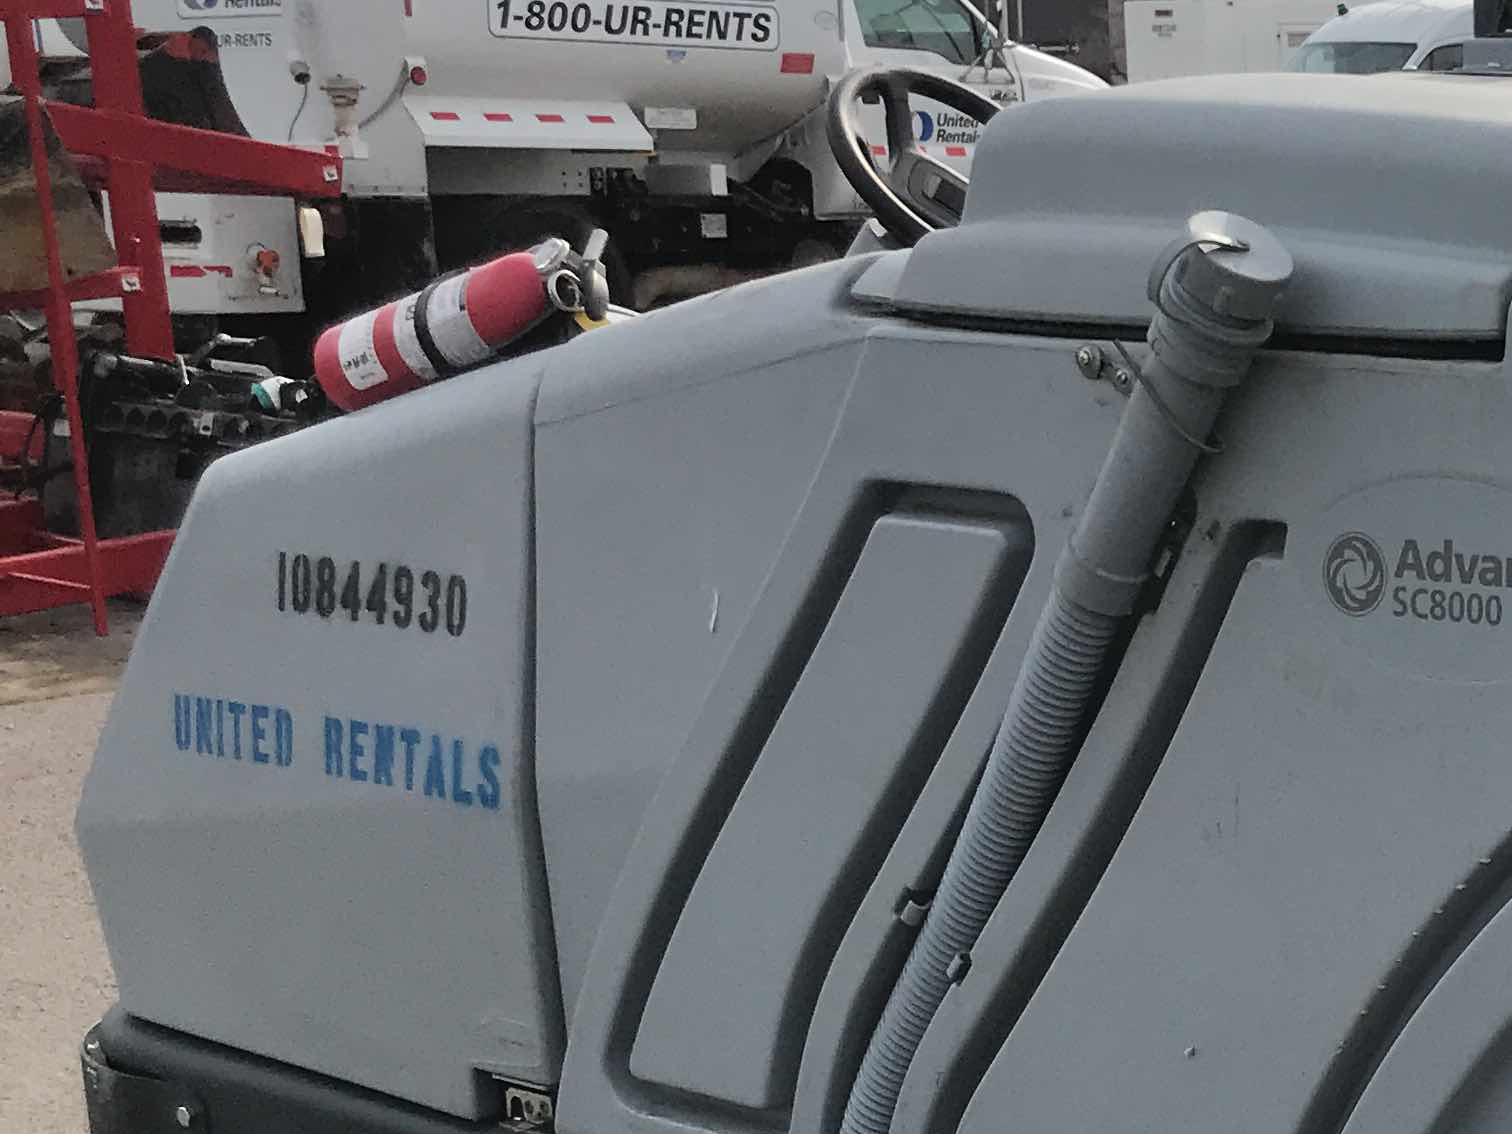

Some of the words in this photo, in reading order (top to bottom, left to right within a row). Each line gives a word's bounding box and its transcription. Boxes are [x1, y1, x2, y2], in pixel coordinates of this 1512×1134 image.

[496, 0, 772, 43] 1-800-UR-RENTS
[936, 128, 980, 144] Rental
[277, 551, 468, 637] 10844930
[1392, 586, 1503, 626] SC8000
[174, 695, 294, 768] UNITED
[324, 715, 502, 812] RENTALS
